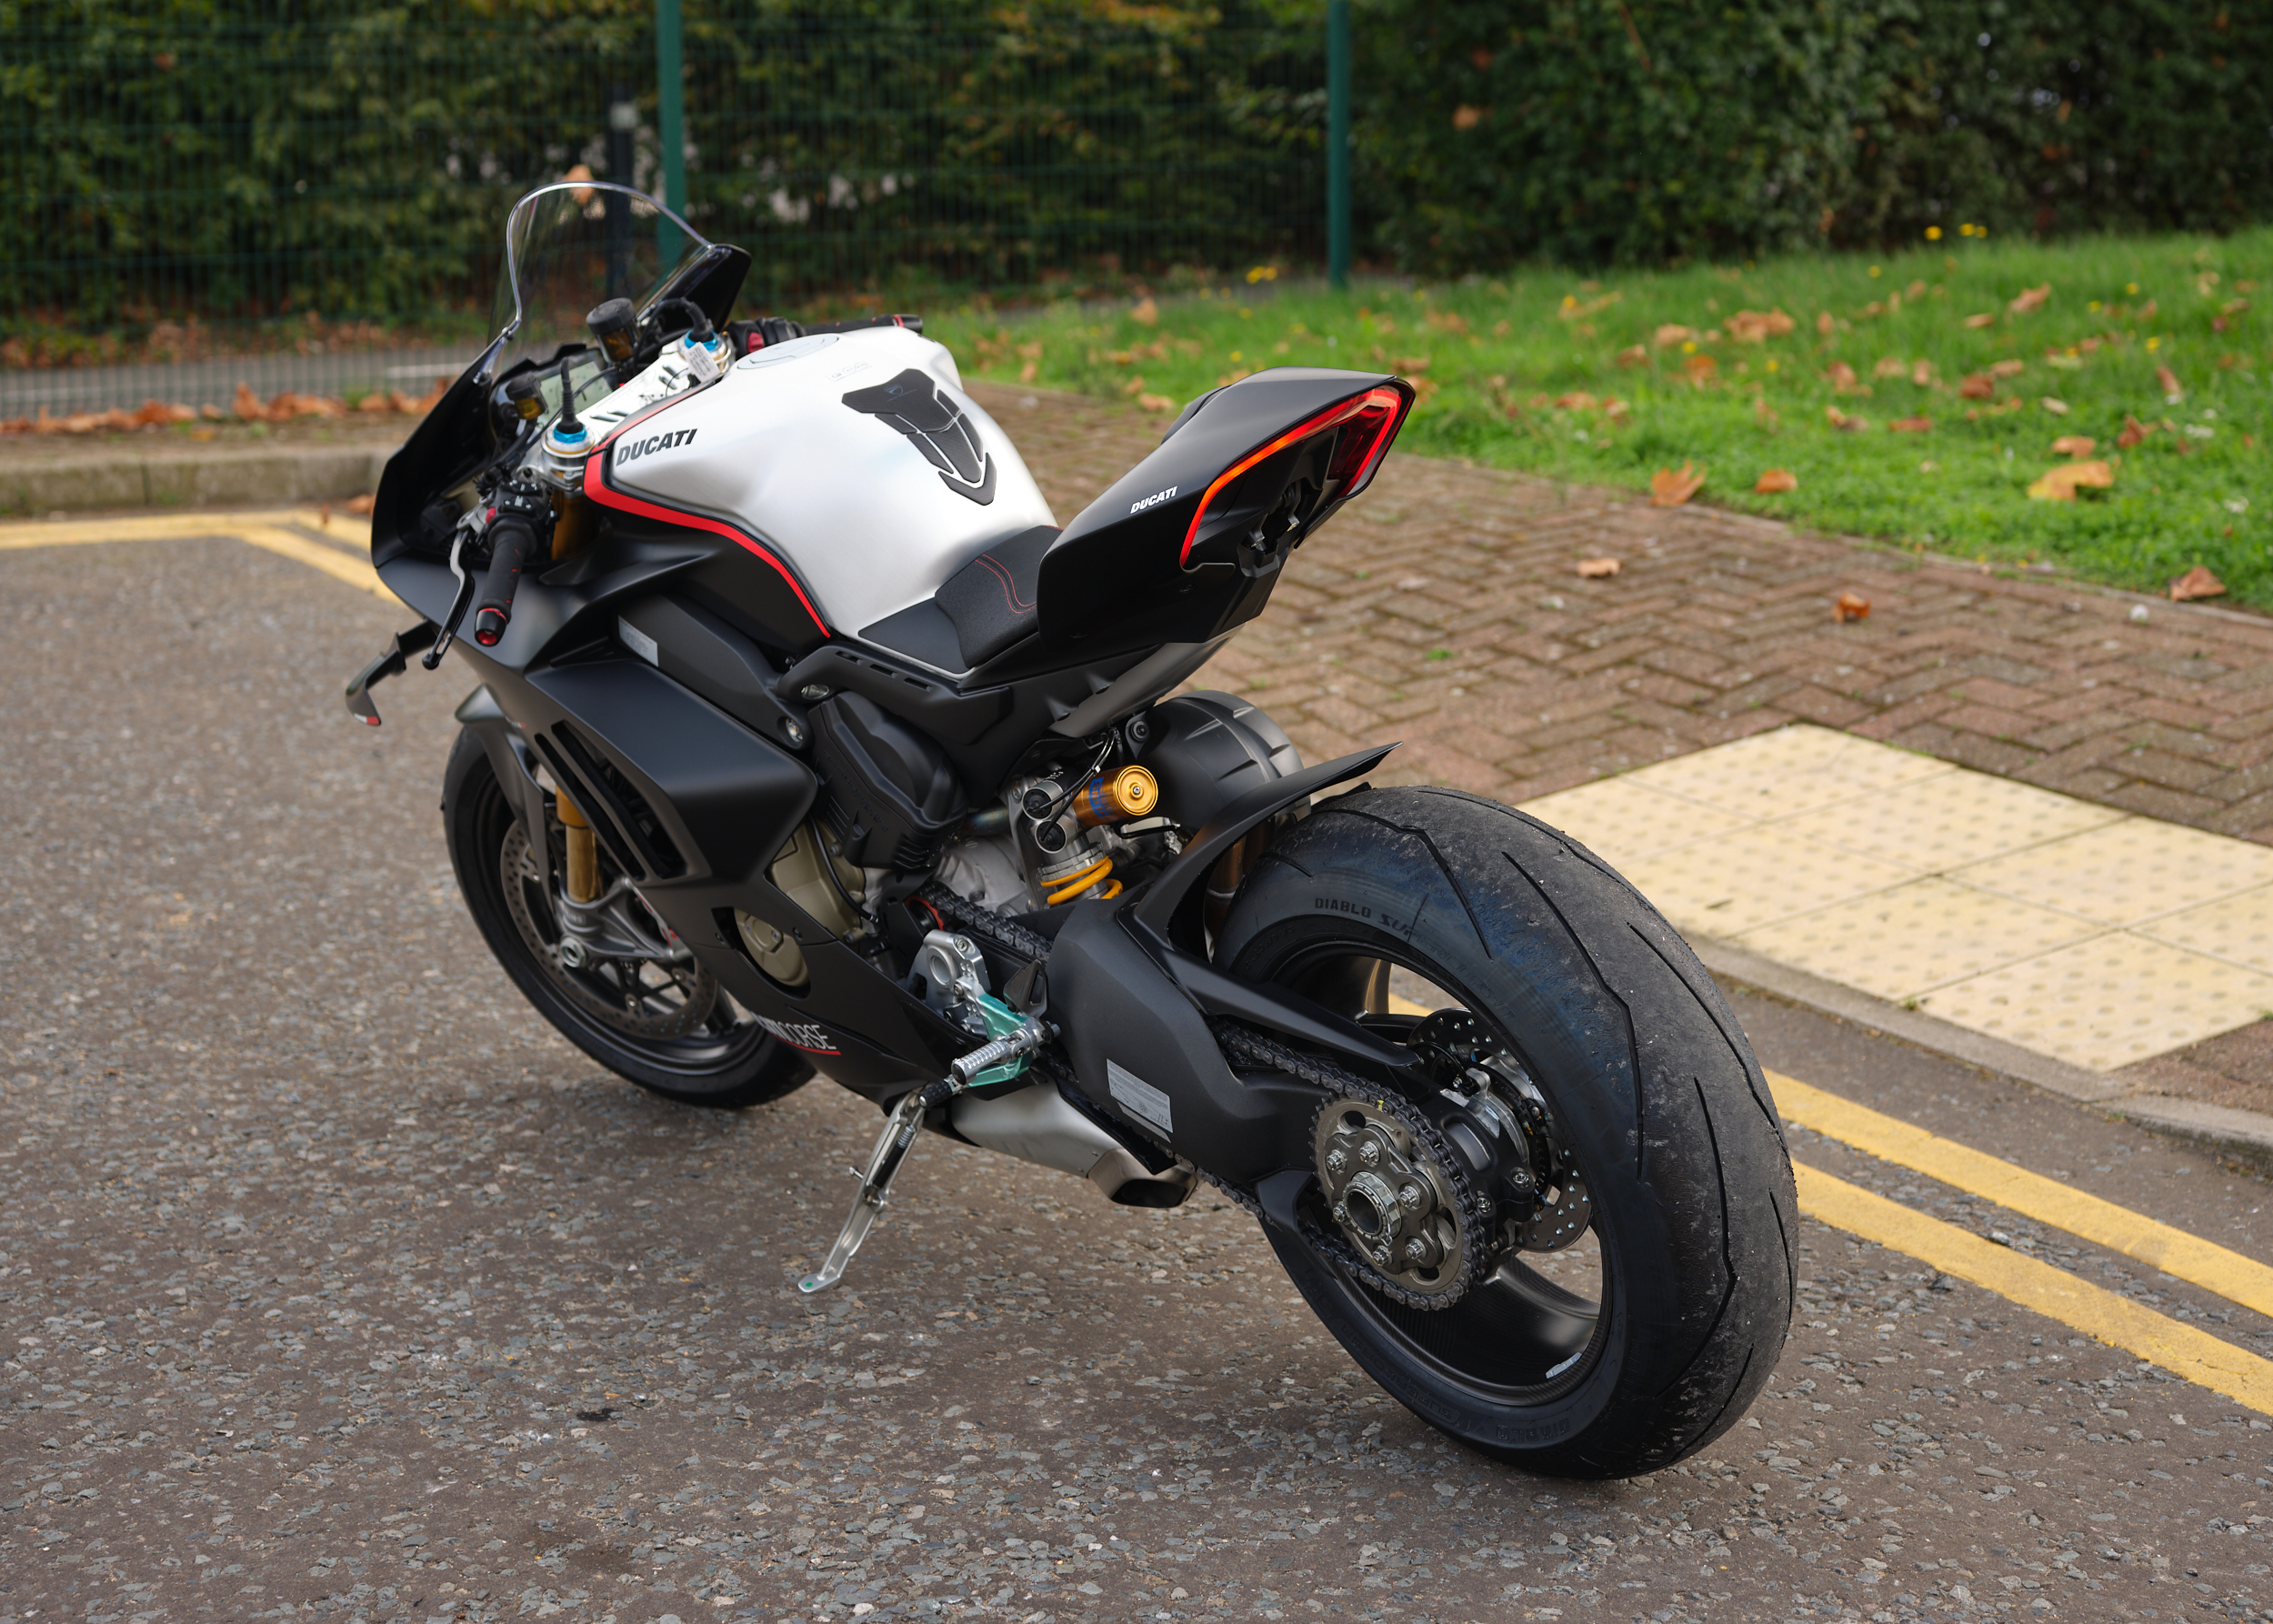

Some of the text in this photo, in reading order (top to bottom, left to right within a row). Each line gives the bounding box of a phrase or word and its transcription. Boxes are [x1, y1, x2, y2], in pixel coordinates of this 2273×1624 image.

[616, 428, 698, 466] DUCATI
[1130, 486, 1177, 514] DUCATI
[1314, 897, 1372, 918] DIABLO
[1378, 913, 1516, 1020] SUPERCORSA
[1497, 1418, 1570, 1442] DIABLO
